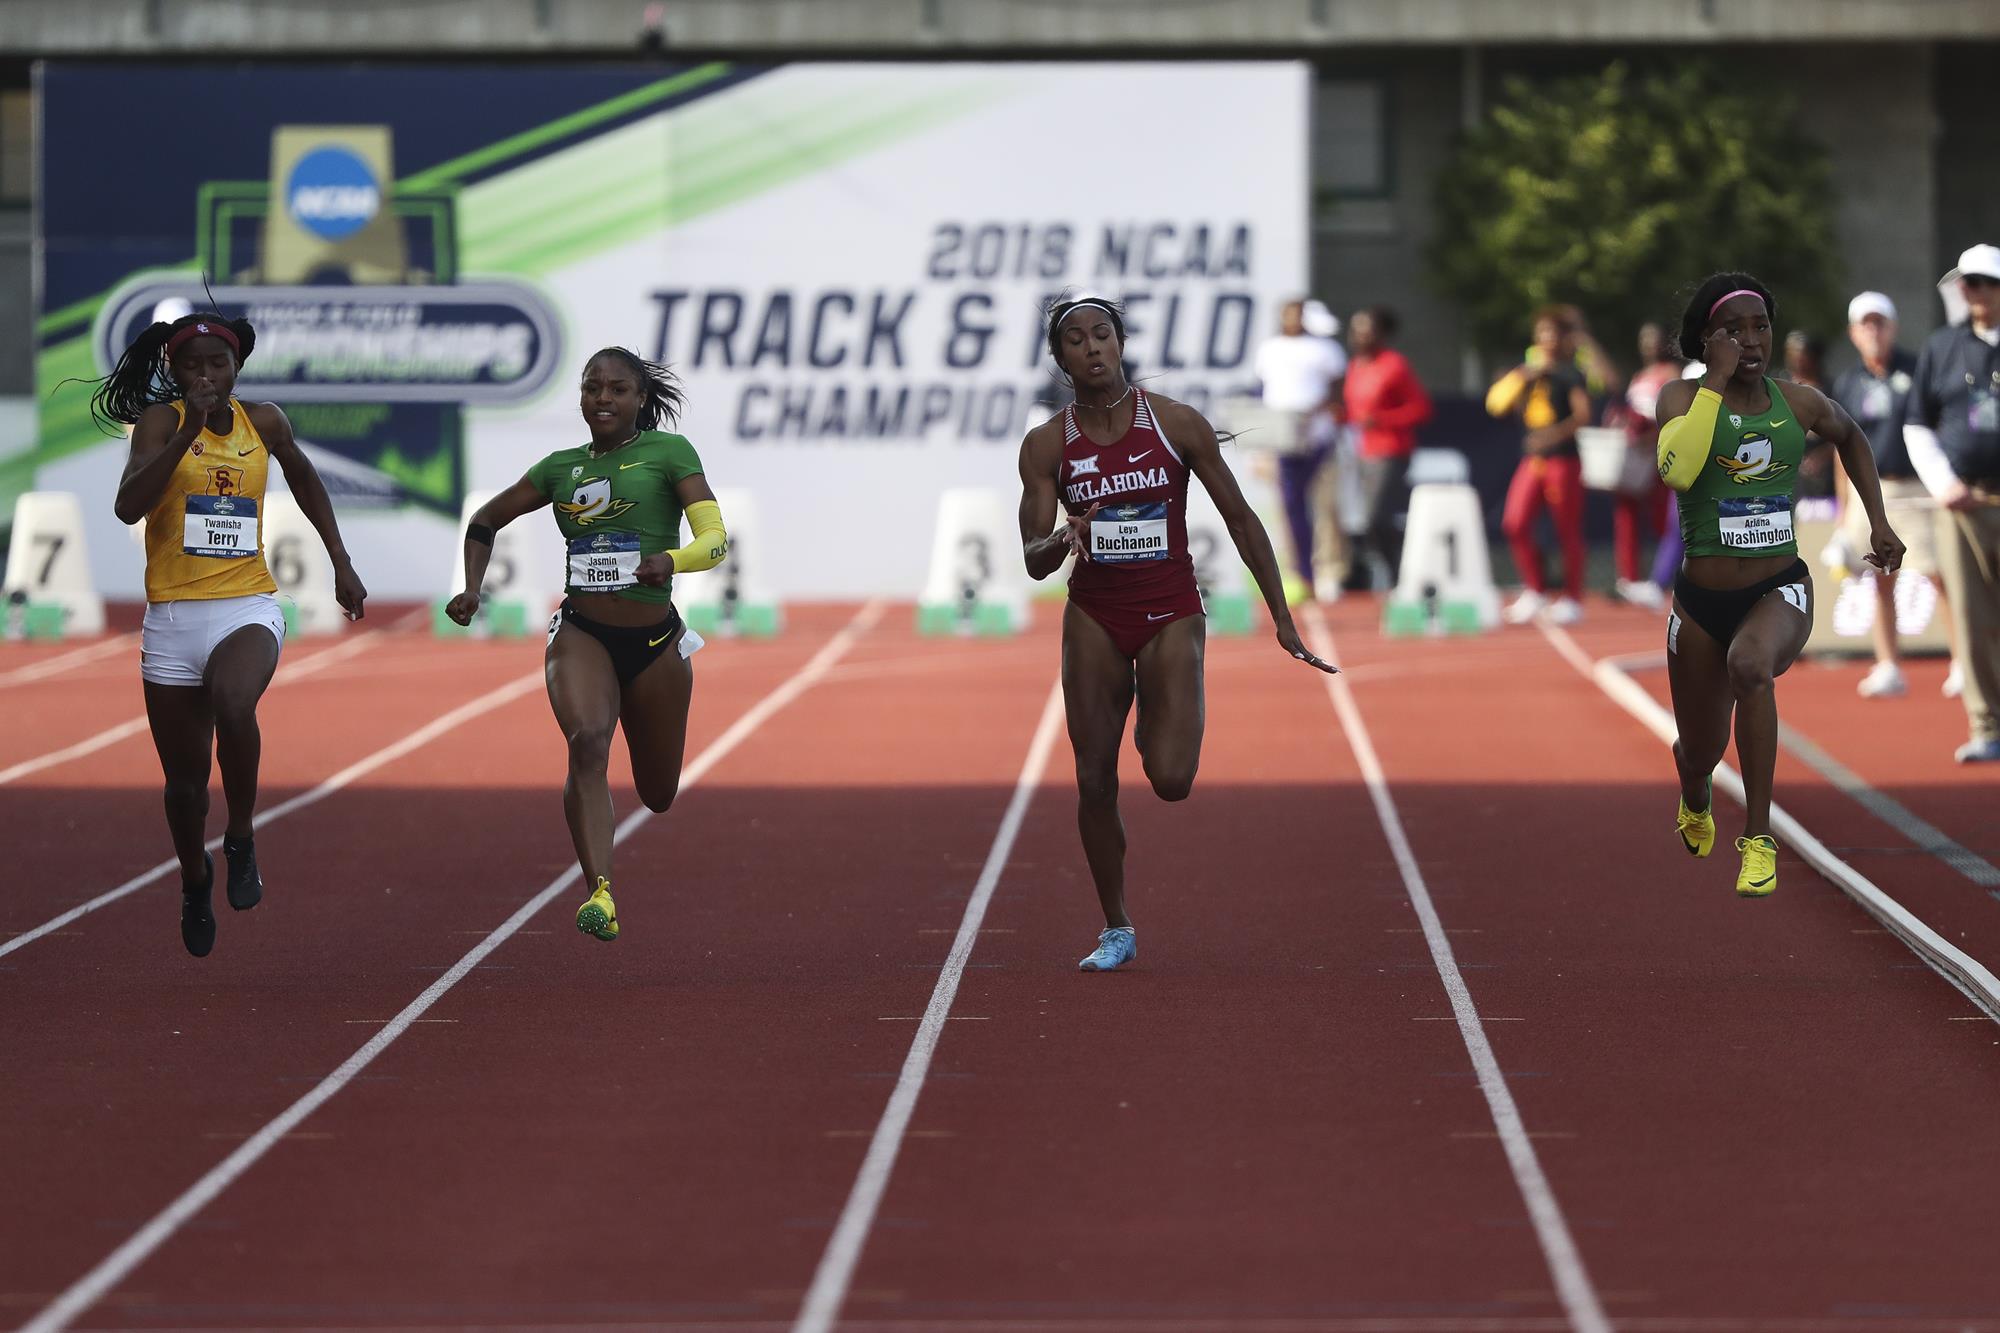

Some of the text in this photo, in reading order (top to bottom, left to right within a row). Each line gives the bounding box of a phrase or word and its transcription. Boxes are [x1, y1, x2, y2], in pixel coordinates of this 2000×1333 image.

[925, 221, 1252, 279] 2018 NCAA
[648, 290, 1257, 370] TRACK & FELD
[1066, 466, 1170, 503] OKLAHOMA
[204, 518, 242, 530] Twanisha
[1118, 524, 1139, 534] Leya
[206, 530, 239, 547] Terry
[1096, 535, 1162, 551] Buchanan
[1721, 527, 1792, 546] Washington
[32, 534, 70, 584] 7
[272, 537, 304, 586] 6
[588, 556, 617, 567] Jasmin
[587, 567, 620, 582] Reed
